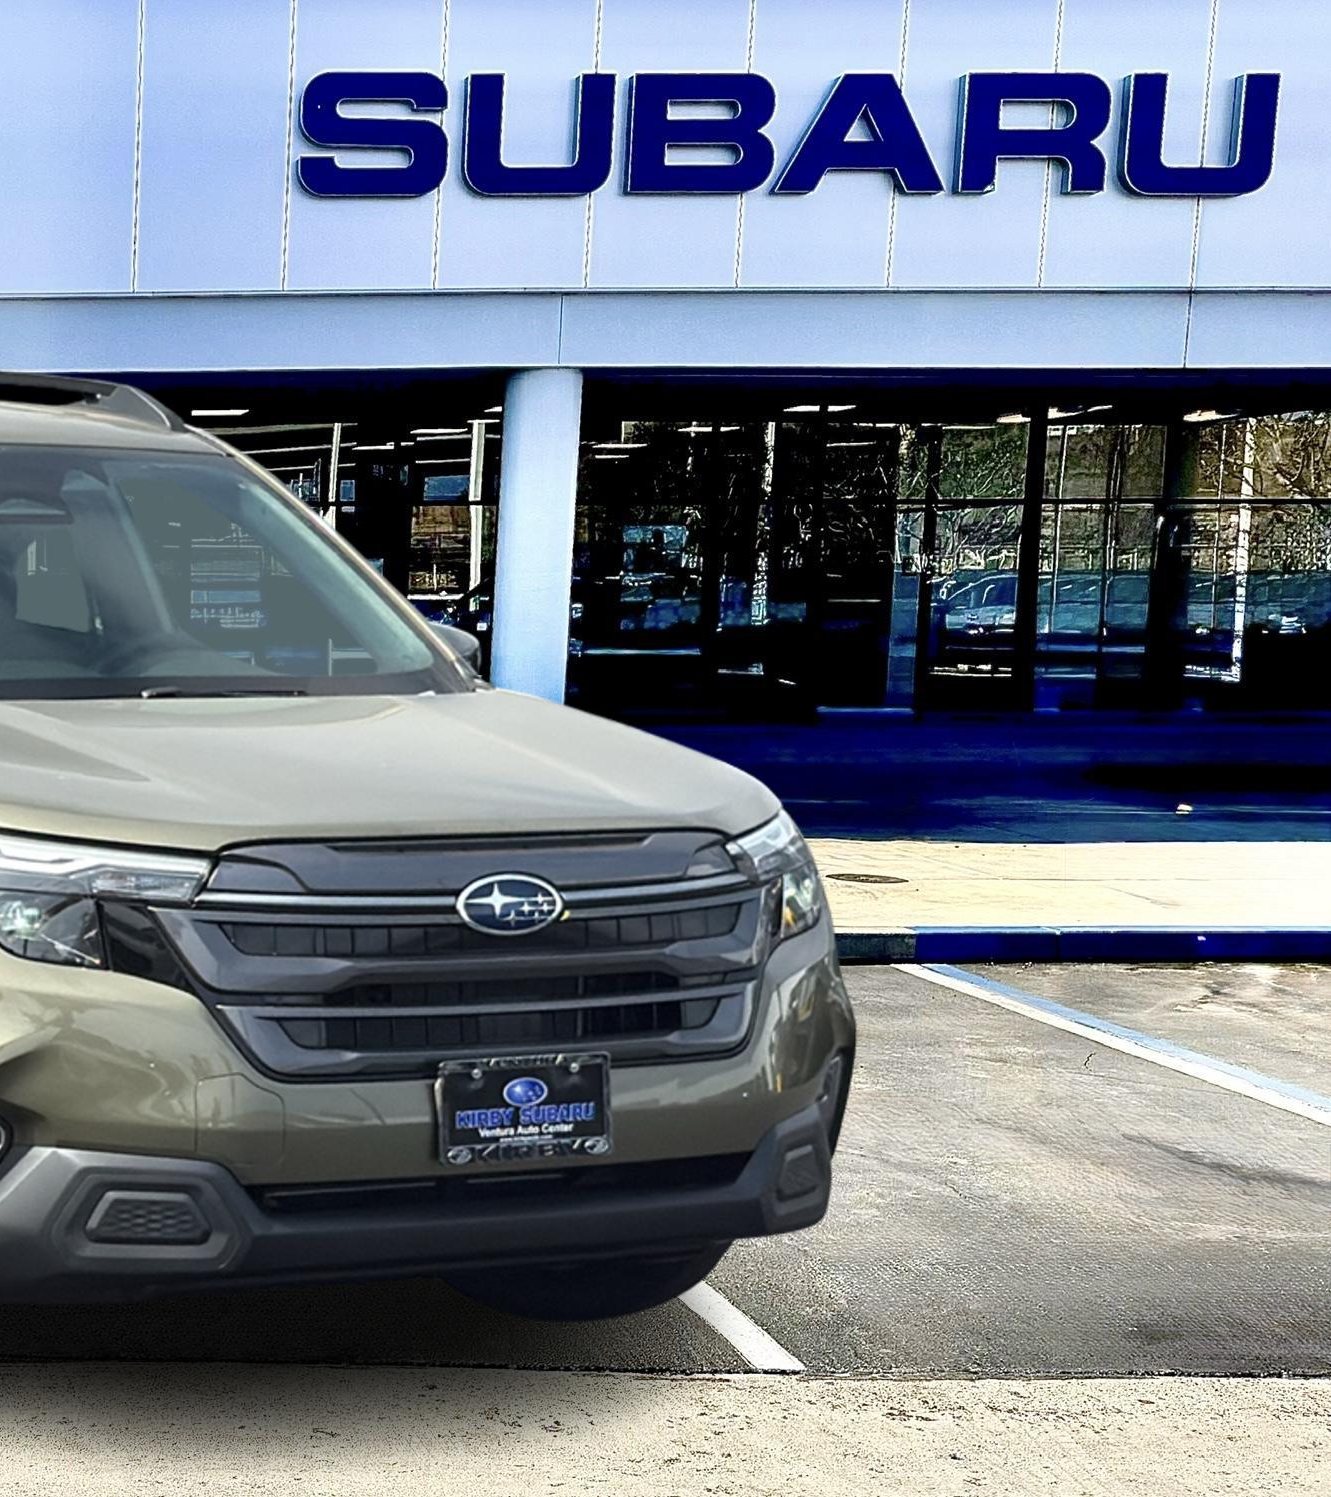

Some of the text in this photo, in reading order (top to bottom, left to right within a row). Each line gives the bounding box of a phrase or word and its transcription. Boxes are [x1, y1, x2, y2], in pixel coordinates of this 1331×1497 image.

[296, 71, 1282, 201] SUBARU
[455, 1102, 595, 1130] KIRBY SUBARU
[478, 1126, 515, 1138] Ventura
[516, 1124, 540, 1135] Auto
[541, 1123, 574, 1134] Center
